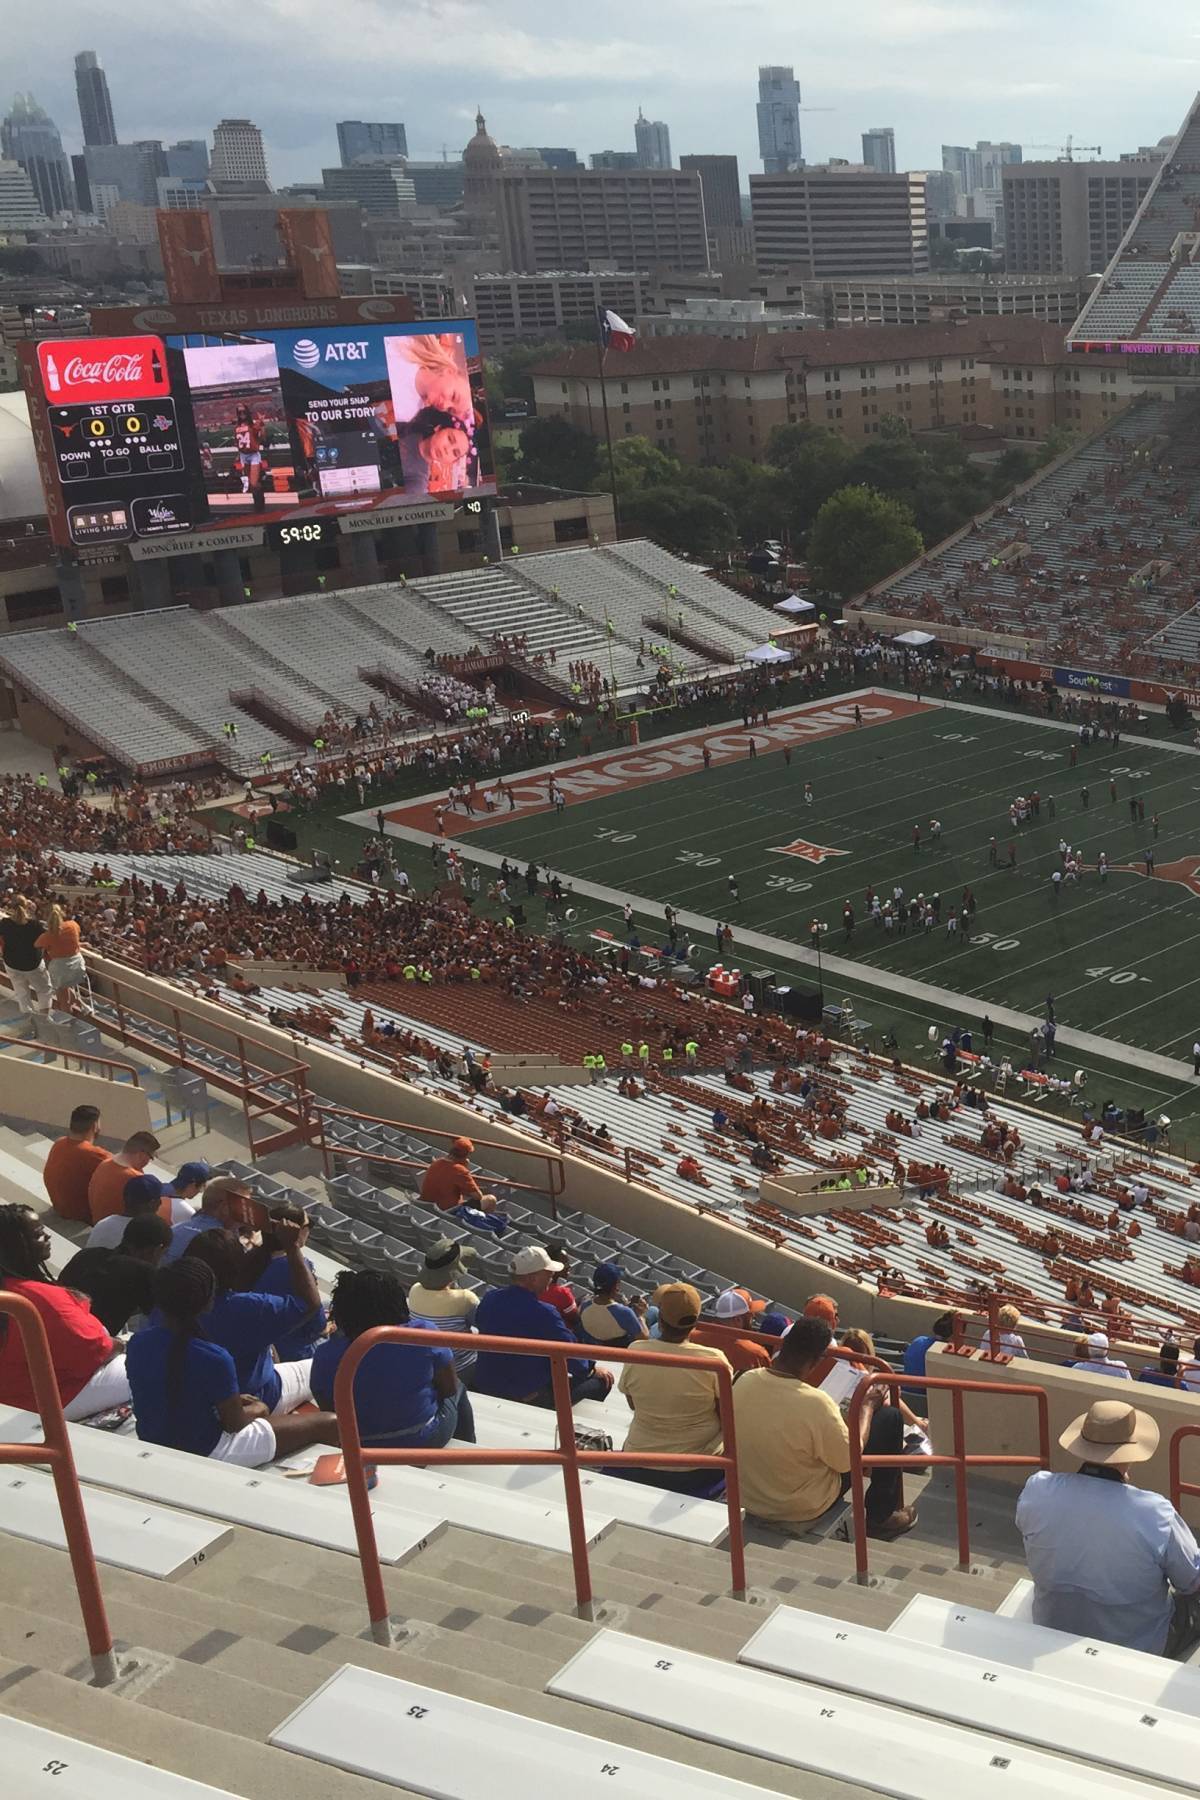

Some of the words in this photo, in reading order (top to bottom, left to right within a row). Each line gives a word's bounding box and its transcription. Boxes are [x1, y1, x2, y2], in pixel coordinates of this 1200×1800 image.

[197, 310, 248, 327] TEXAS
[255, 305, 338, 325] LONGHORNS
[325, 341, 369, 362] AT&T
[1120, 343, 1161, 354] UNIVERSITY
[64, 354, 144, 385] Coca-Cola
[90, 406, 108, 416] 1ST
[112, 404, 135, 414] QTR
[308, 399, 328, 408] SEND
[329, 398, 348, 407] YOUR
[350, 396, 369, 405] SNAP
[305, 412, 319, 422] TO
[321, 410, 342, 421] OUR
[344, 407, 376, 418] STORY
[91, 420, 104, 436] 0
[127, 417, 140, 433] 0
[60, 451, 91, 461] DOWN
[101, 449, 113, 458] TO
[116, 448, 130, 456] GO
[139, 445, 162, 454] BALL
[164, 443, 177, 452] ON
[467, 501, 481, 513] 40
[348, 515, 394, 529] MONCRIEF
[404, 509, 447, 520] COMPLEX
[75, 526, 100, 536] LIVING
[280, 524, 322, 544] 59:02
[141, 540, 195, 556] MONCRIEF
[206, 533, 255, 548] COMPLEX
[1068, 674, 1112, 690] Soutest
[446, 702, 894, 822] LONGHORNS
[594, 827, 637, 843] 10
[675, 851, 722, 867] 20
[765, 875, 813, 893] 30
[969, 932, 1020, 951] 50
[1084, 966, 1137, 984] 40
[193, 1552, 205, 1566] 16
[835, 1632, 848, 1641] 24
[654, 1660, 674, 1671] 25
[982, 1672, 999, 1682] 23
[406, 1705, 430, 1719] 25
[820, 1708, 836, 1718] 24
[42, 1760, 69, 1775] 25
[600, 1764, 620, 1776] 24
